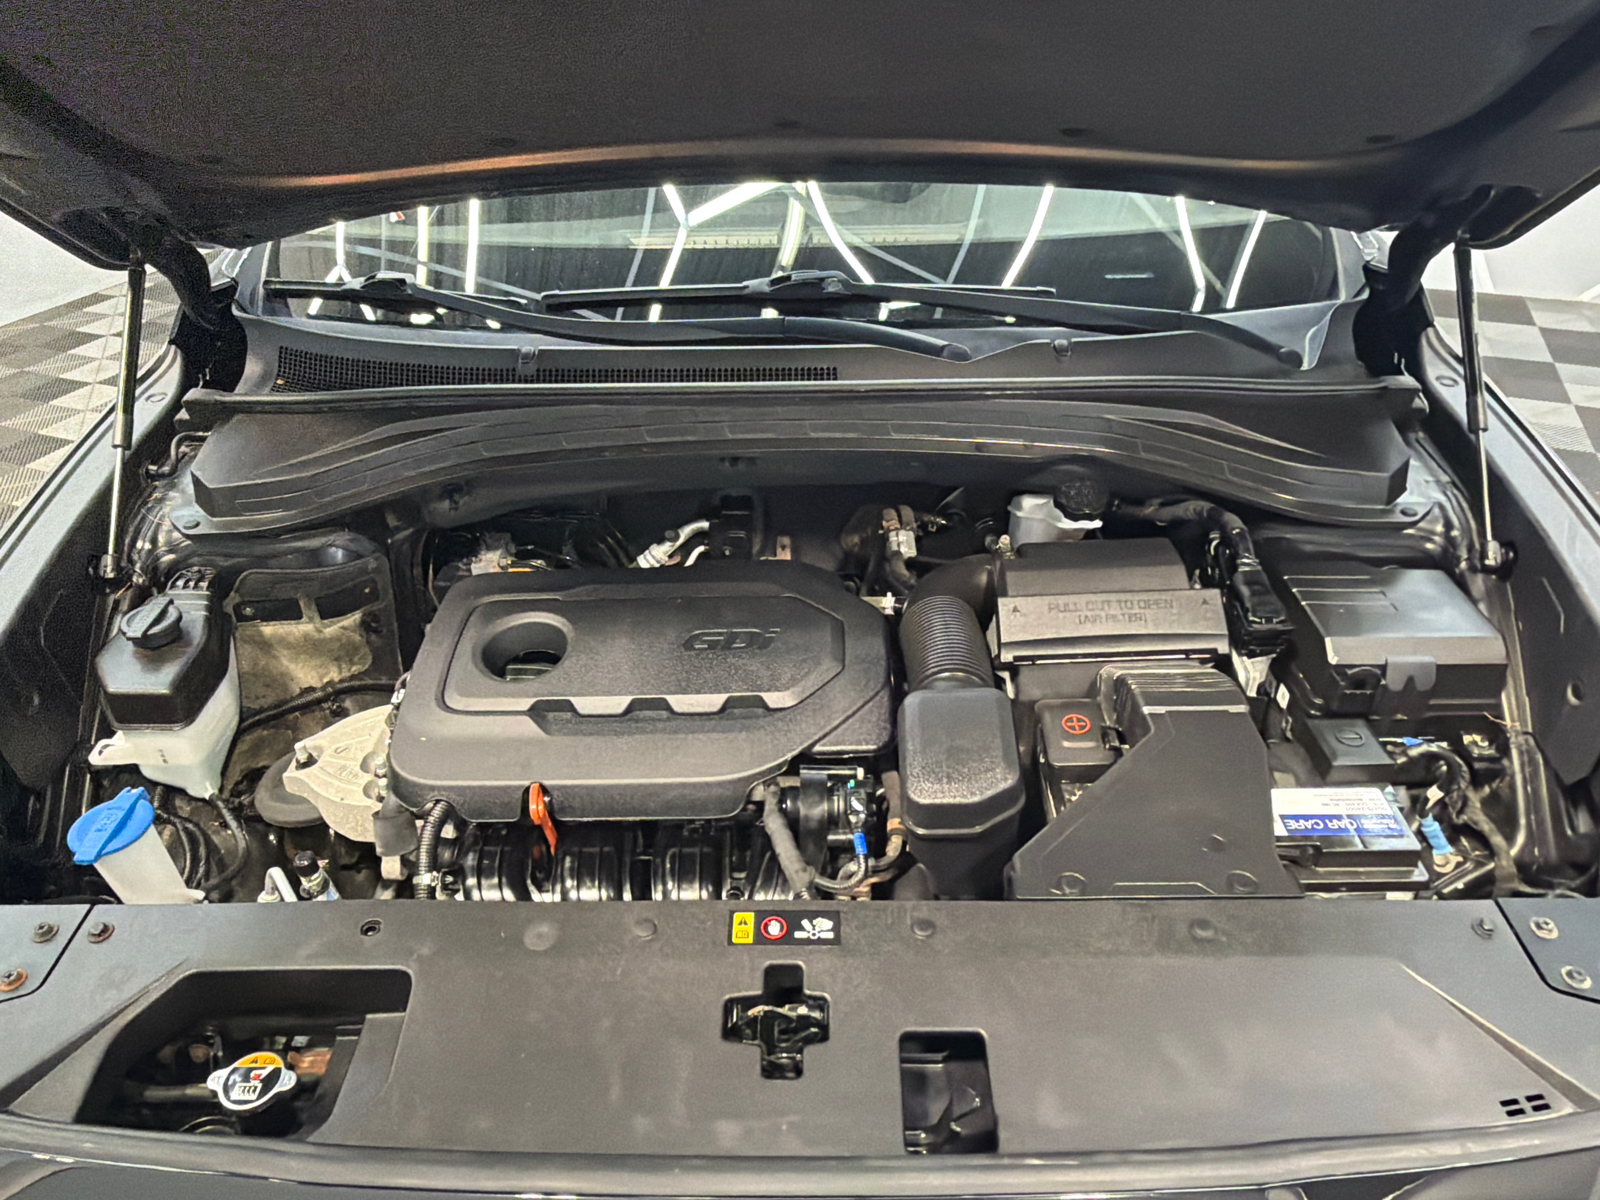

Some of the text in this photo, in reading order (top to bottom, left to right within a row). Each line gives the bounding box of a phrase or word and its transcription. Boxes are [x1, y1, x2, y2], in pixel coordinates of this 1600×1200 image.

[1048, 598, 1174, 613] PULL OUT TO OPEN
[1284, 819, 1324, 830] CARE
[1325, 819, 1357, 830] CAR
